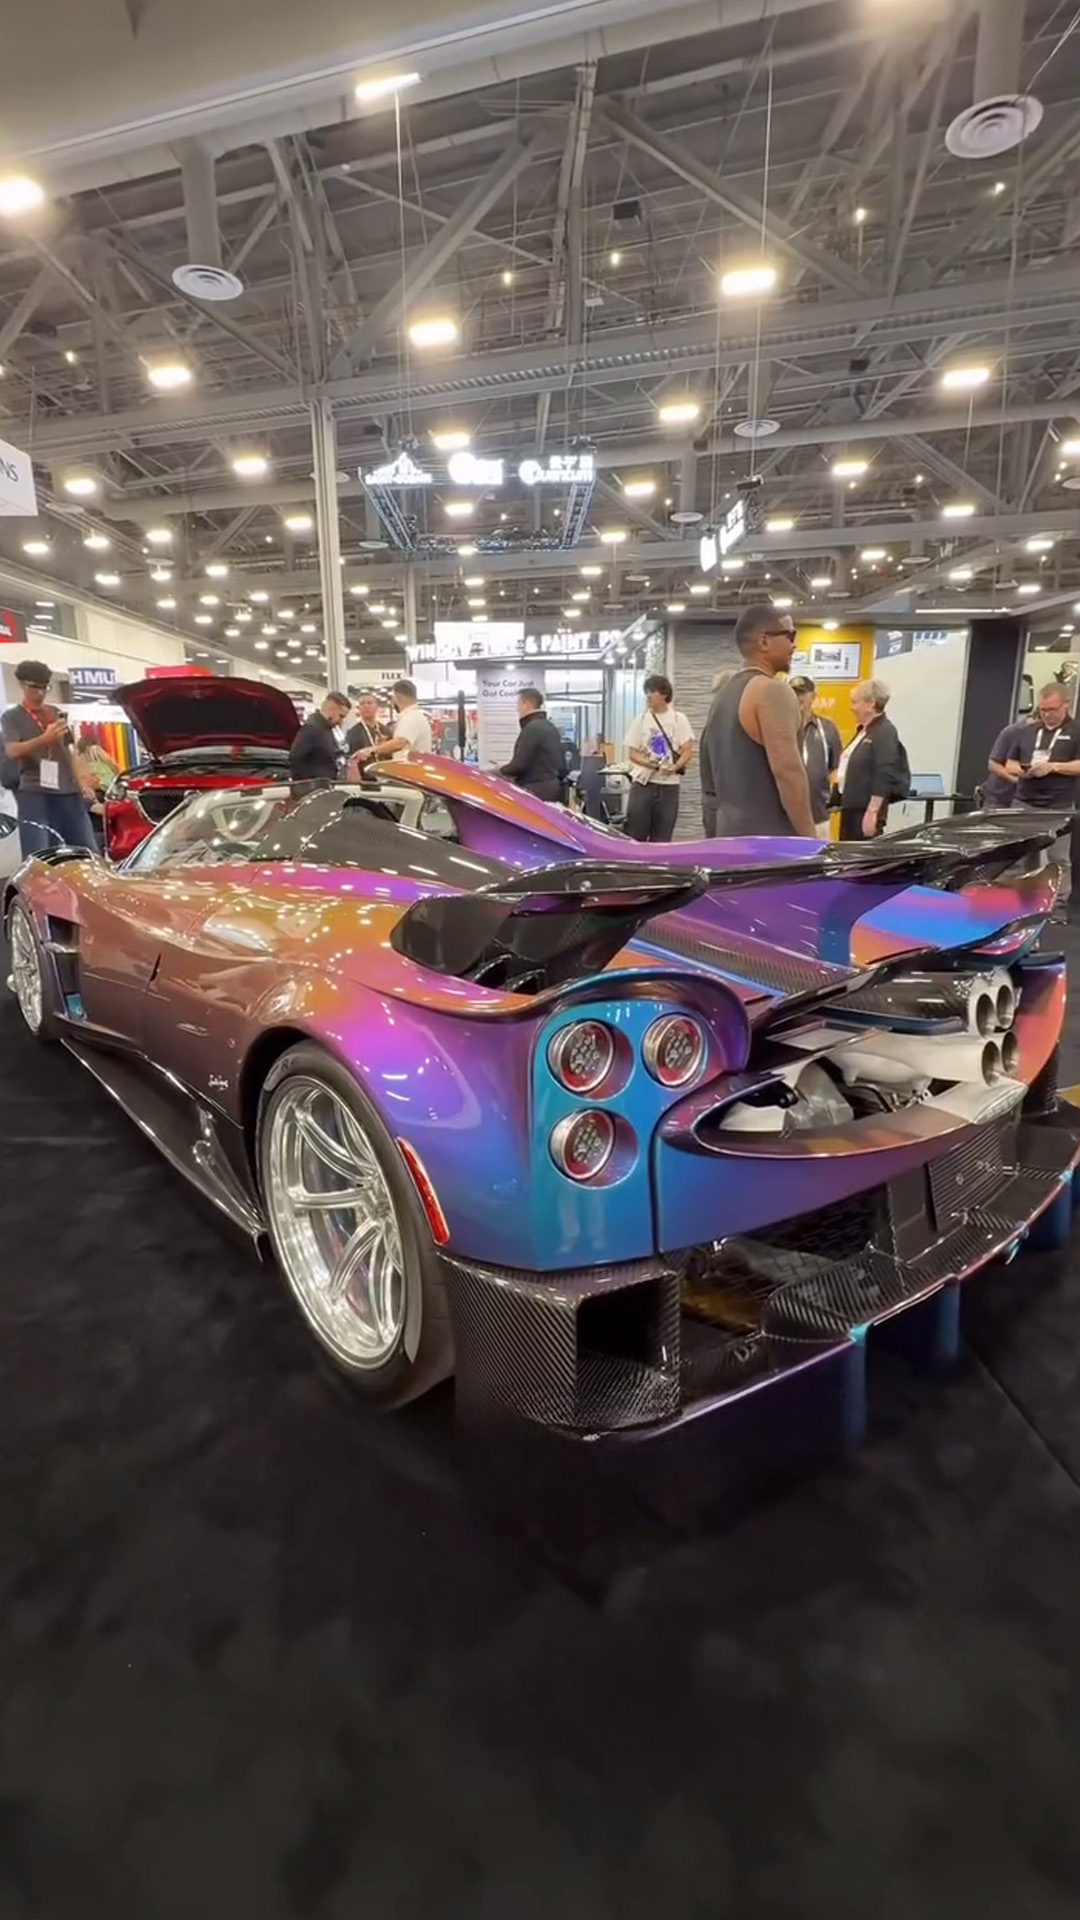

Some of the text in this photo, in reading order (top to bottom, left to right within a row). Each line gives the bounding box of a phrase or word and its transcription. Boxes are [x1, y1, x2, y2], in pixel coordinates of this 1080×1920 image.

[541, 632, 590, 651] PAINT
[381, 672, 402, 680] FLEX
[481, 679, 500, 688] Your
[502, 679, 517, 687] Car
[482, 688, 498, 697] Got
